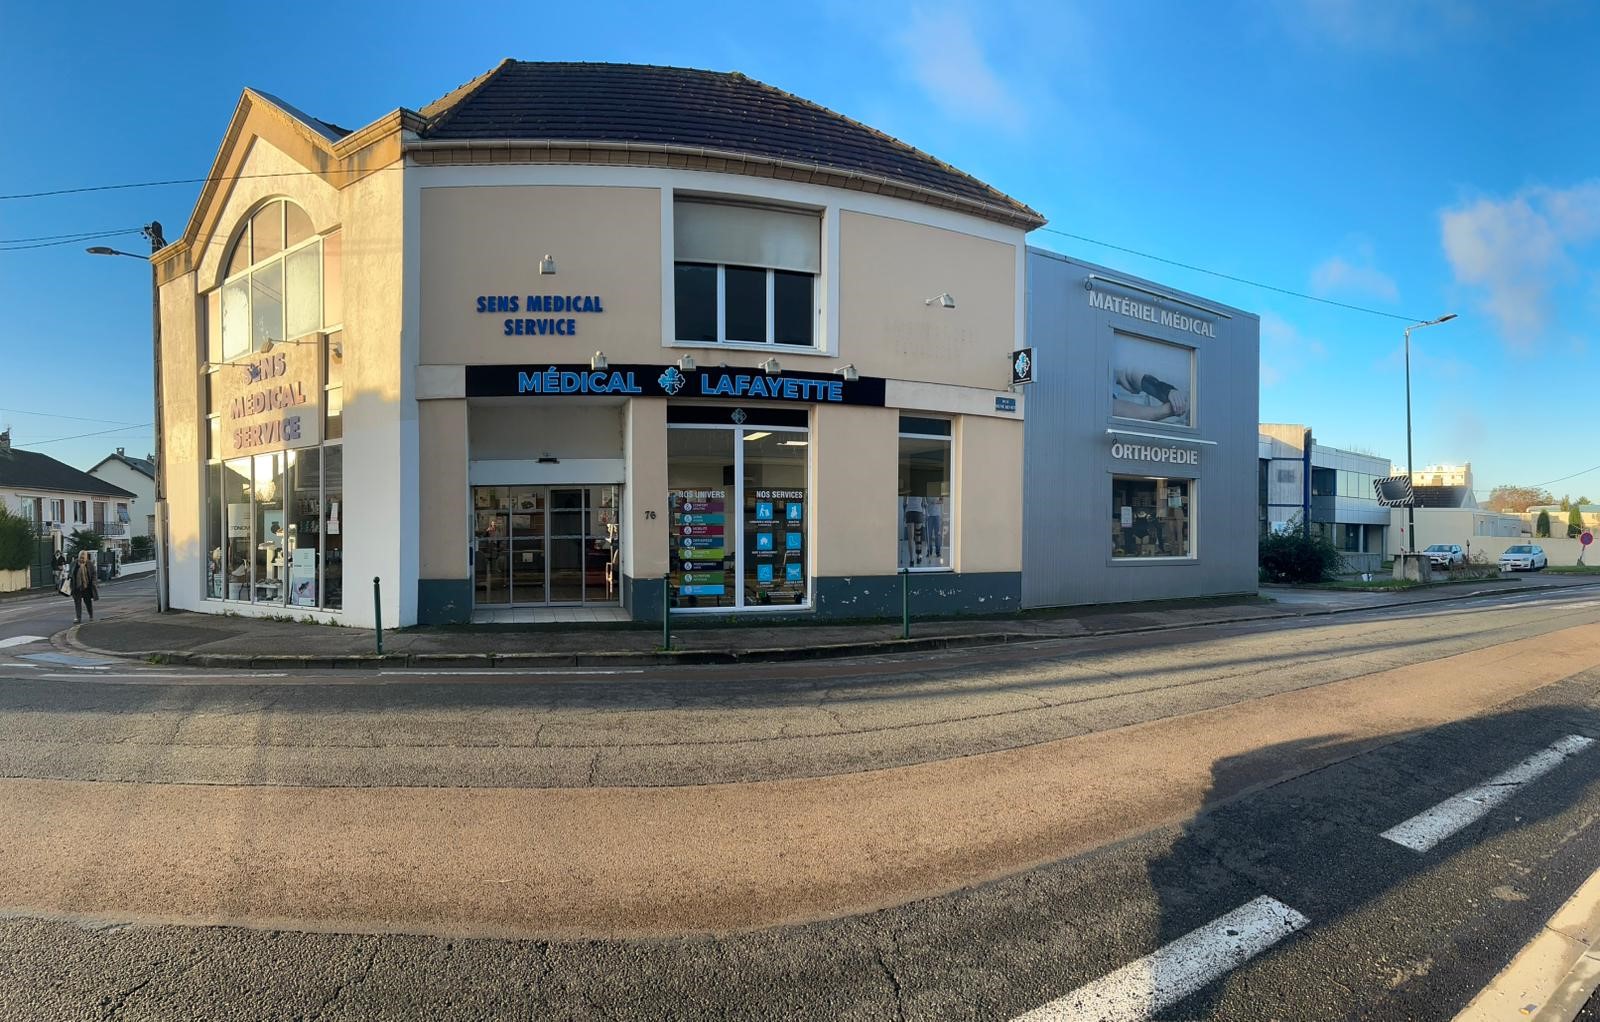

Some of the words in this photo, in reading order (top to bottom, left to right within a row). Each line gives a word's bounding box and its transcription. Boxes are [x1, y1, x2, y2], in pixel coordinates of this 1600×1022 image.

[476, 295, 519, 313] SENS
[526, 295, 603, 313] MEDICAL
[1089, 290, 1158, 323] MATÉRIEL
[1161, 310, 1216, 338] MÉDICAL
[504, 318, 576, 336] SERVICE
[518, 365, 642, 393] MÉDICAL
[701, 373, 843, 401] LAFAYETTE
[231, 381, 306, 420] MEDICAL
[233, 415, 301, 449] SERVICE
[1111, 443, 1198, 465] ORTHOPÉDIE
[679, 490, 694, 499] NOS
[695, 490, 725, 499] UNIVERS
[756, 490, 770, 498] NOS
[771, 490, 803, 499] SERVICES
[644, 510, 657, 520] 76
